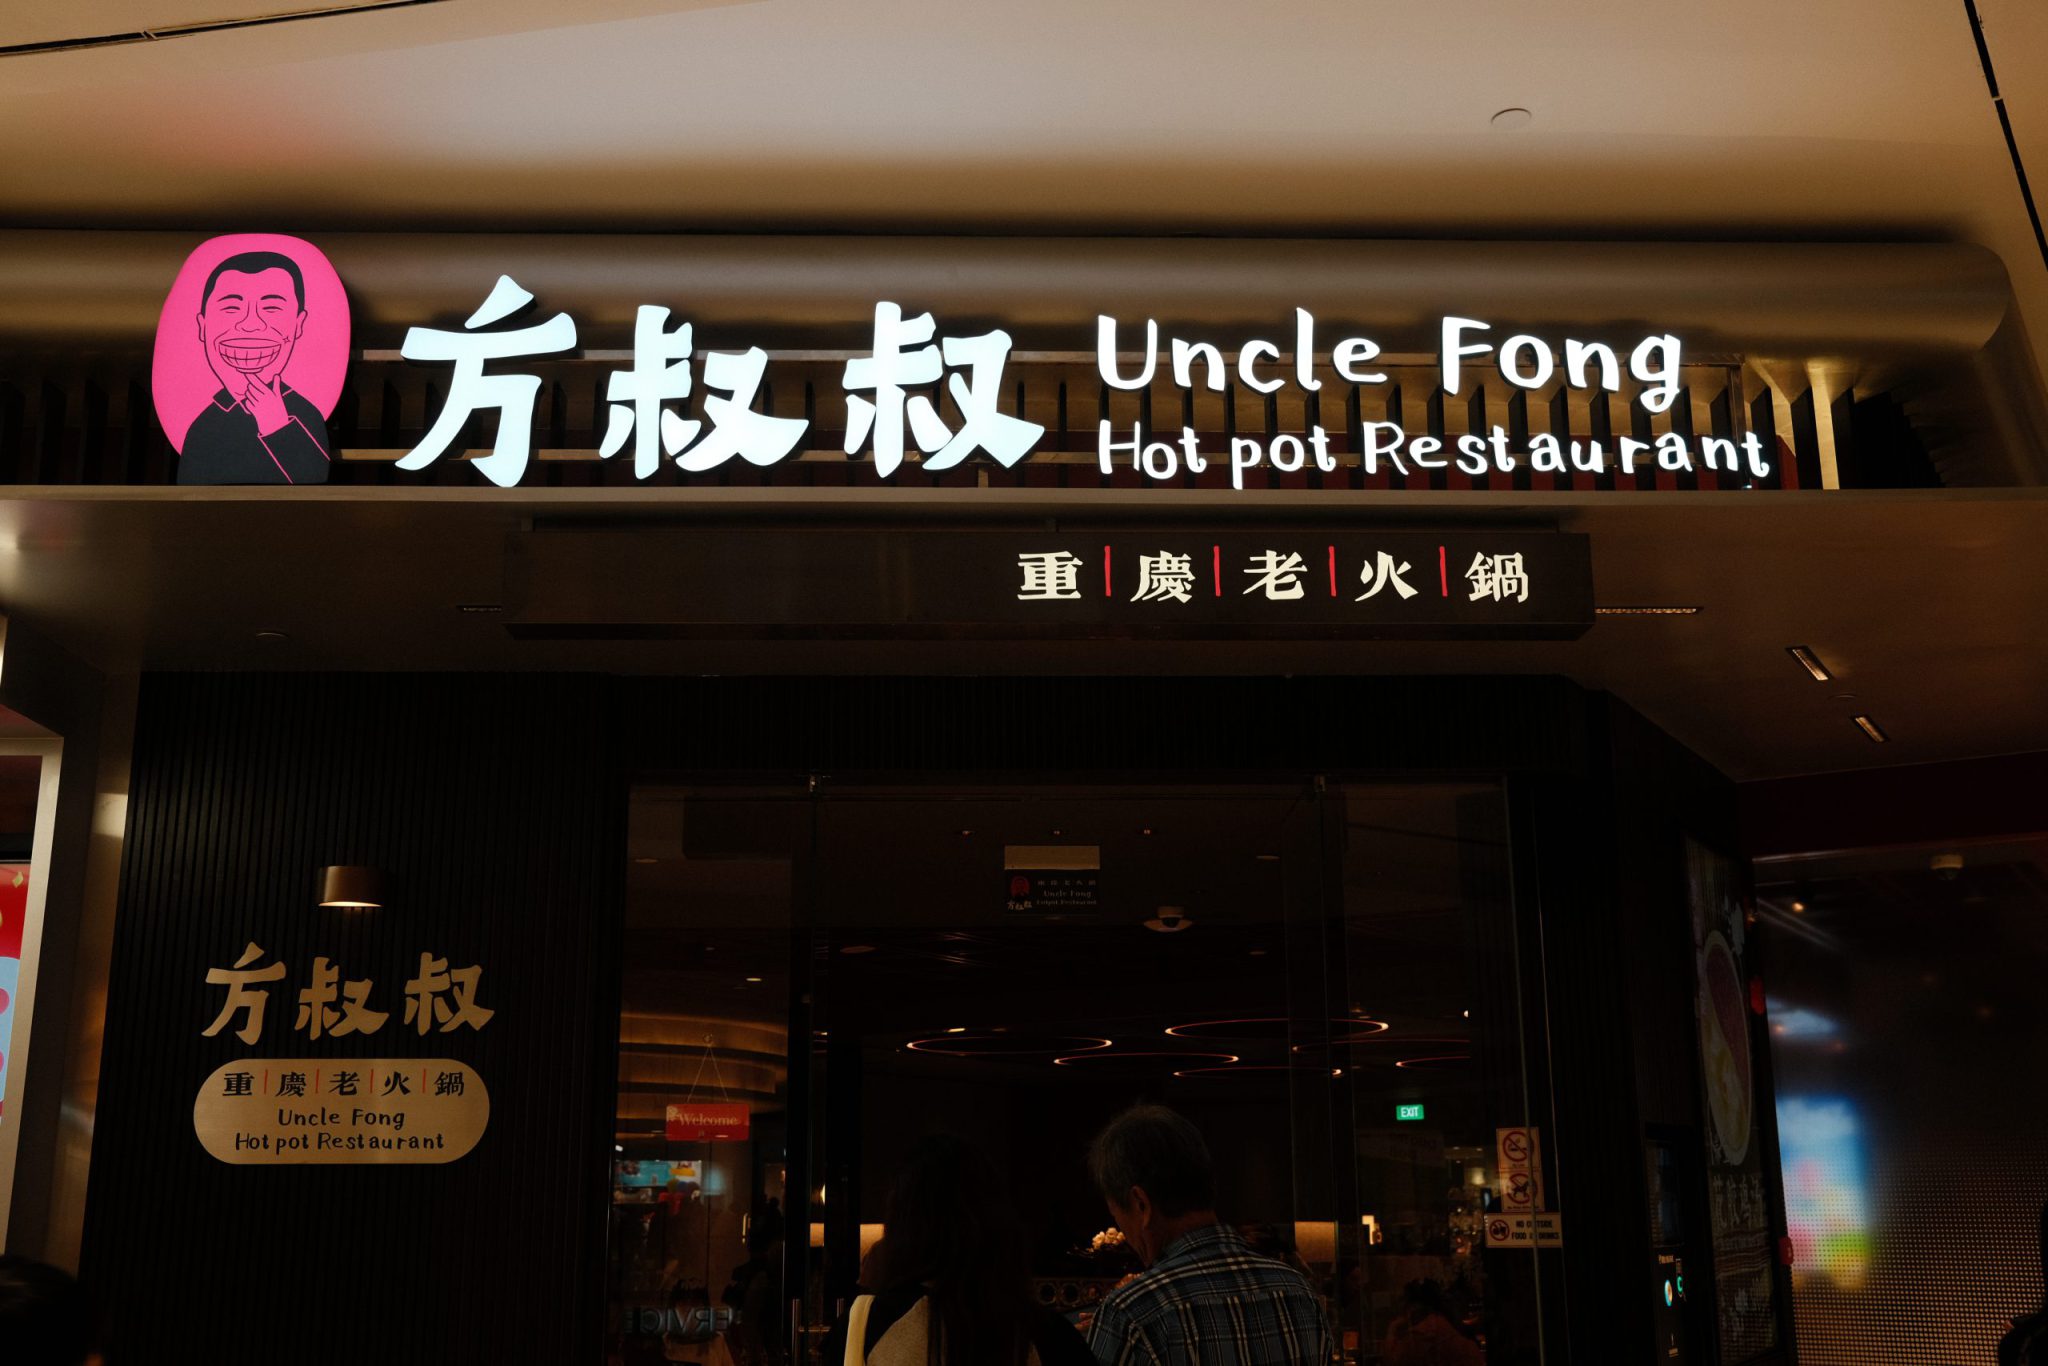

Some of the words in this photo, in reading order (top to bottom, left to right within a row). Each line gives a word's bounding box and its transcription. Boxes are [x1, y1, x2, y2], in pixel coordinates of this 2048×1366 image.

[395, 275, 1044, 488] 方叔叔
[1097, 307, 1388, 393] Uncle
[1441, 316, 1681, 413] Fong
[1098, 419, 1207, 480] Hot
[1231, 425, 1337, 490] pot
[1362, 421, 1771, 478] Restaurant
[202, 941, 495, 1046] 方叔叔
[277, 1107, 341, 1126] Uncle
[351, 1108, 405, 1131] Fong
[680, 1112, 738, 1127] Welcome
[1400, 1107, 1418, 1117] EXIT
[235, 1132, 270, 1151] Hot
[275, 1133, 310, 1155] pot
[317, 1132, 445, 1151] Restaurant
